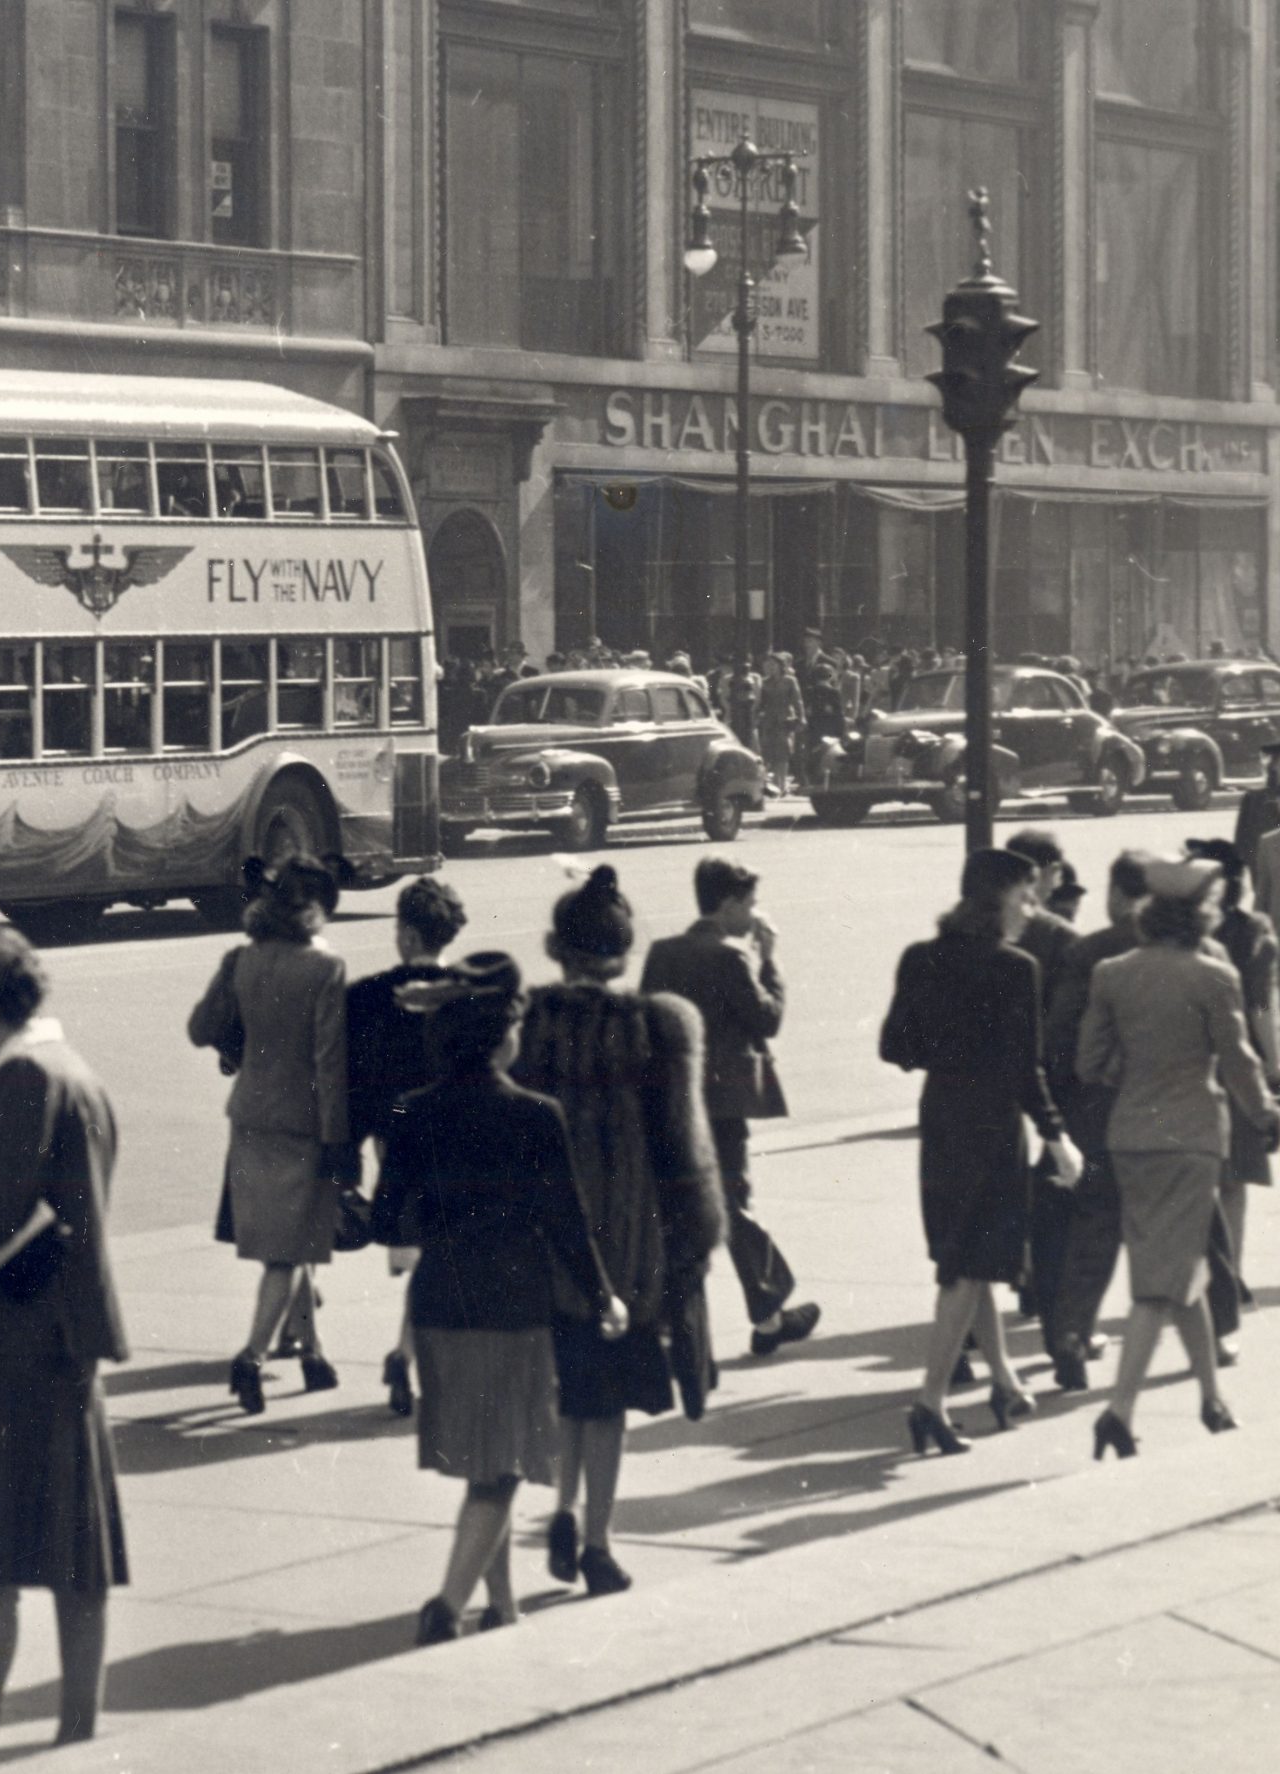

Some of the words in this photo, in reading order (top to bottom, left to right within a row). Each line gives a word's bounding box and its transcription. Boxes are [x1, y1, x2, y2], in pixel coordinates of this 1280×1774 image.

[695, 107, 750, 144] ENTIRE
[757, 114, 817, 155] BUILDING
[759, 163, 810, 206] RET
[787, 297, 809, 321] AVE
[604, 390, 884, 459] SHANGHAI
[928, 408, 1055, 466] LIEN
[205, 558, 268, 603] FLY
[271, 558, 301, 578] WITH
[302, 558, 384, 603] NAVY
[272, 583, 296, 602] THE
[1, 769, 64, 789] AVENUE
[81, 765, 135, 786] COACH
[152, 761, 222, 781] COMPANY
